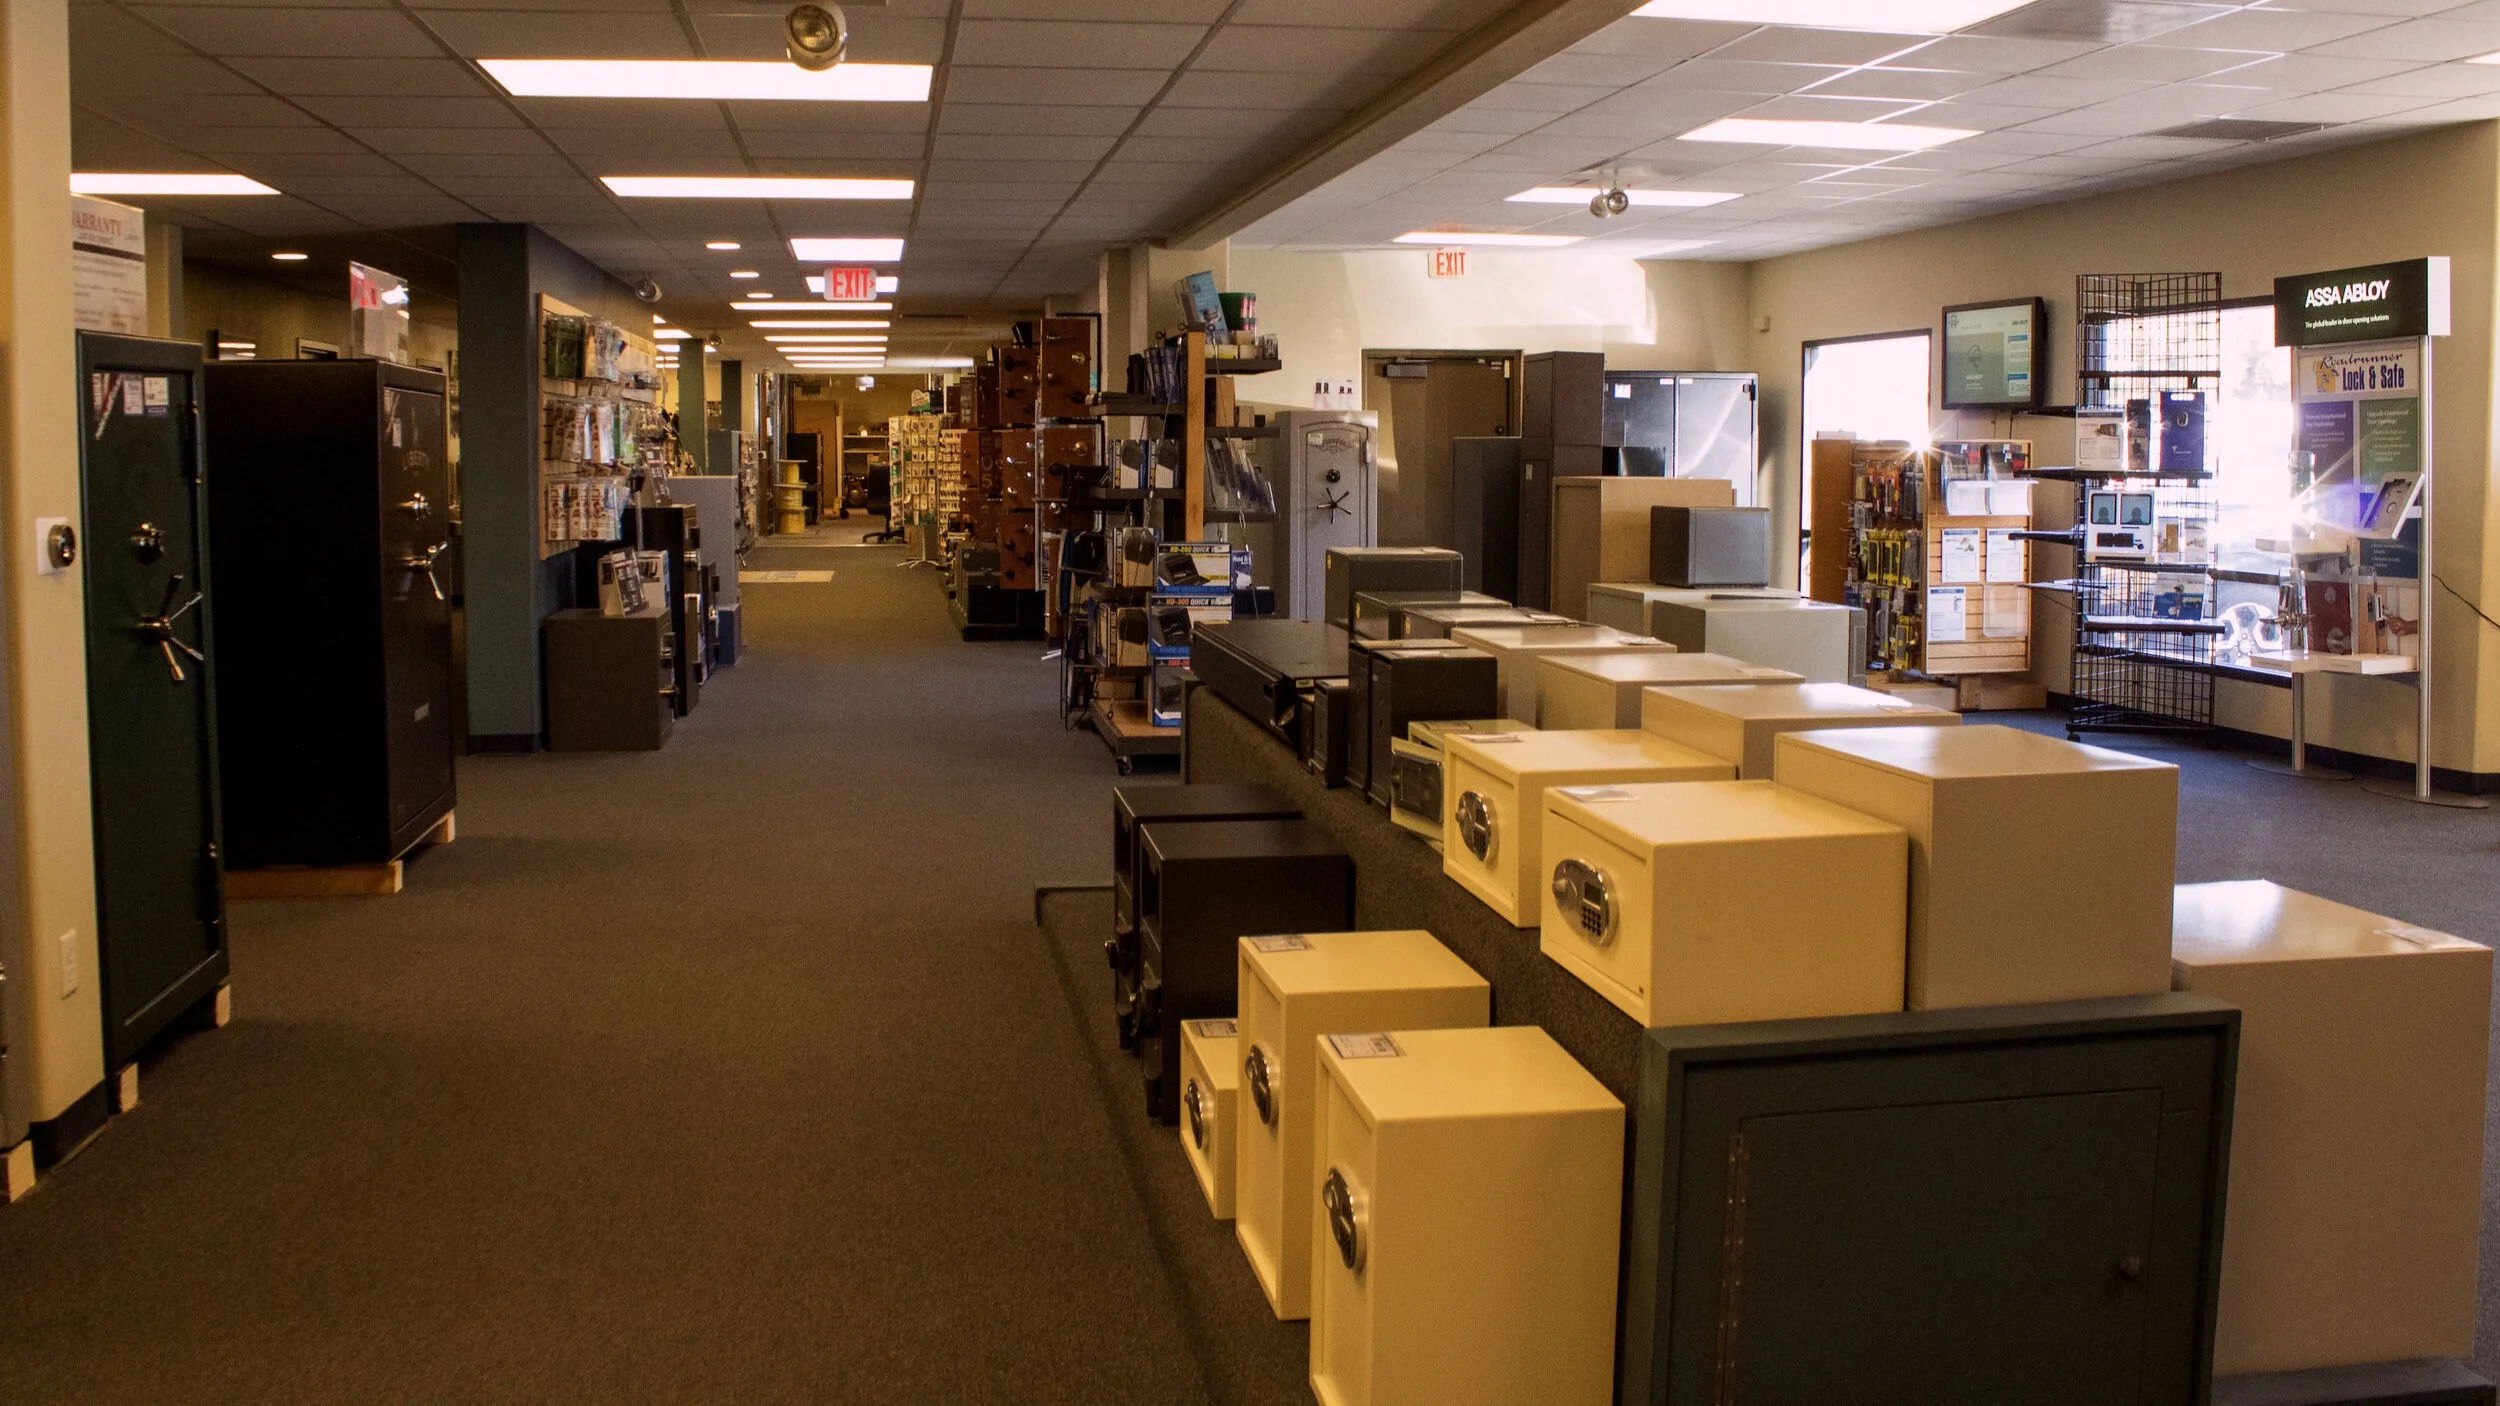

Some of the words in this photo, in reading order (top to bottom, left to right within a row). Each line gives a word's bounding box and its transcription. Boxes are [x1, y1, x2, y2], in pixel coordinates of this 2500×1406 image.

[1436, 252, 1466, 276] EXIT
[832, 268, 871, 298] EXIT
[2305, 286, 2342, 309] ASSA
[2343, 280, 2390, 304] ABLOY
[2313, 320, 2324, 329] global
[2325, 319, 2337, 327] leader
[2353, 316, 2370, 325] opening
[2370, 314, 2389, 322] solutions
[2320, 352, 2403, 369] Roadrunner
[2342, 366, 2365, 391] Lock
[2369, 364, 2376, 390] &
[2380, 363, 2405, 389] Safe
[1190, 598, 1209, 606] QUICK
